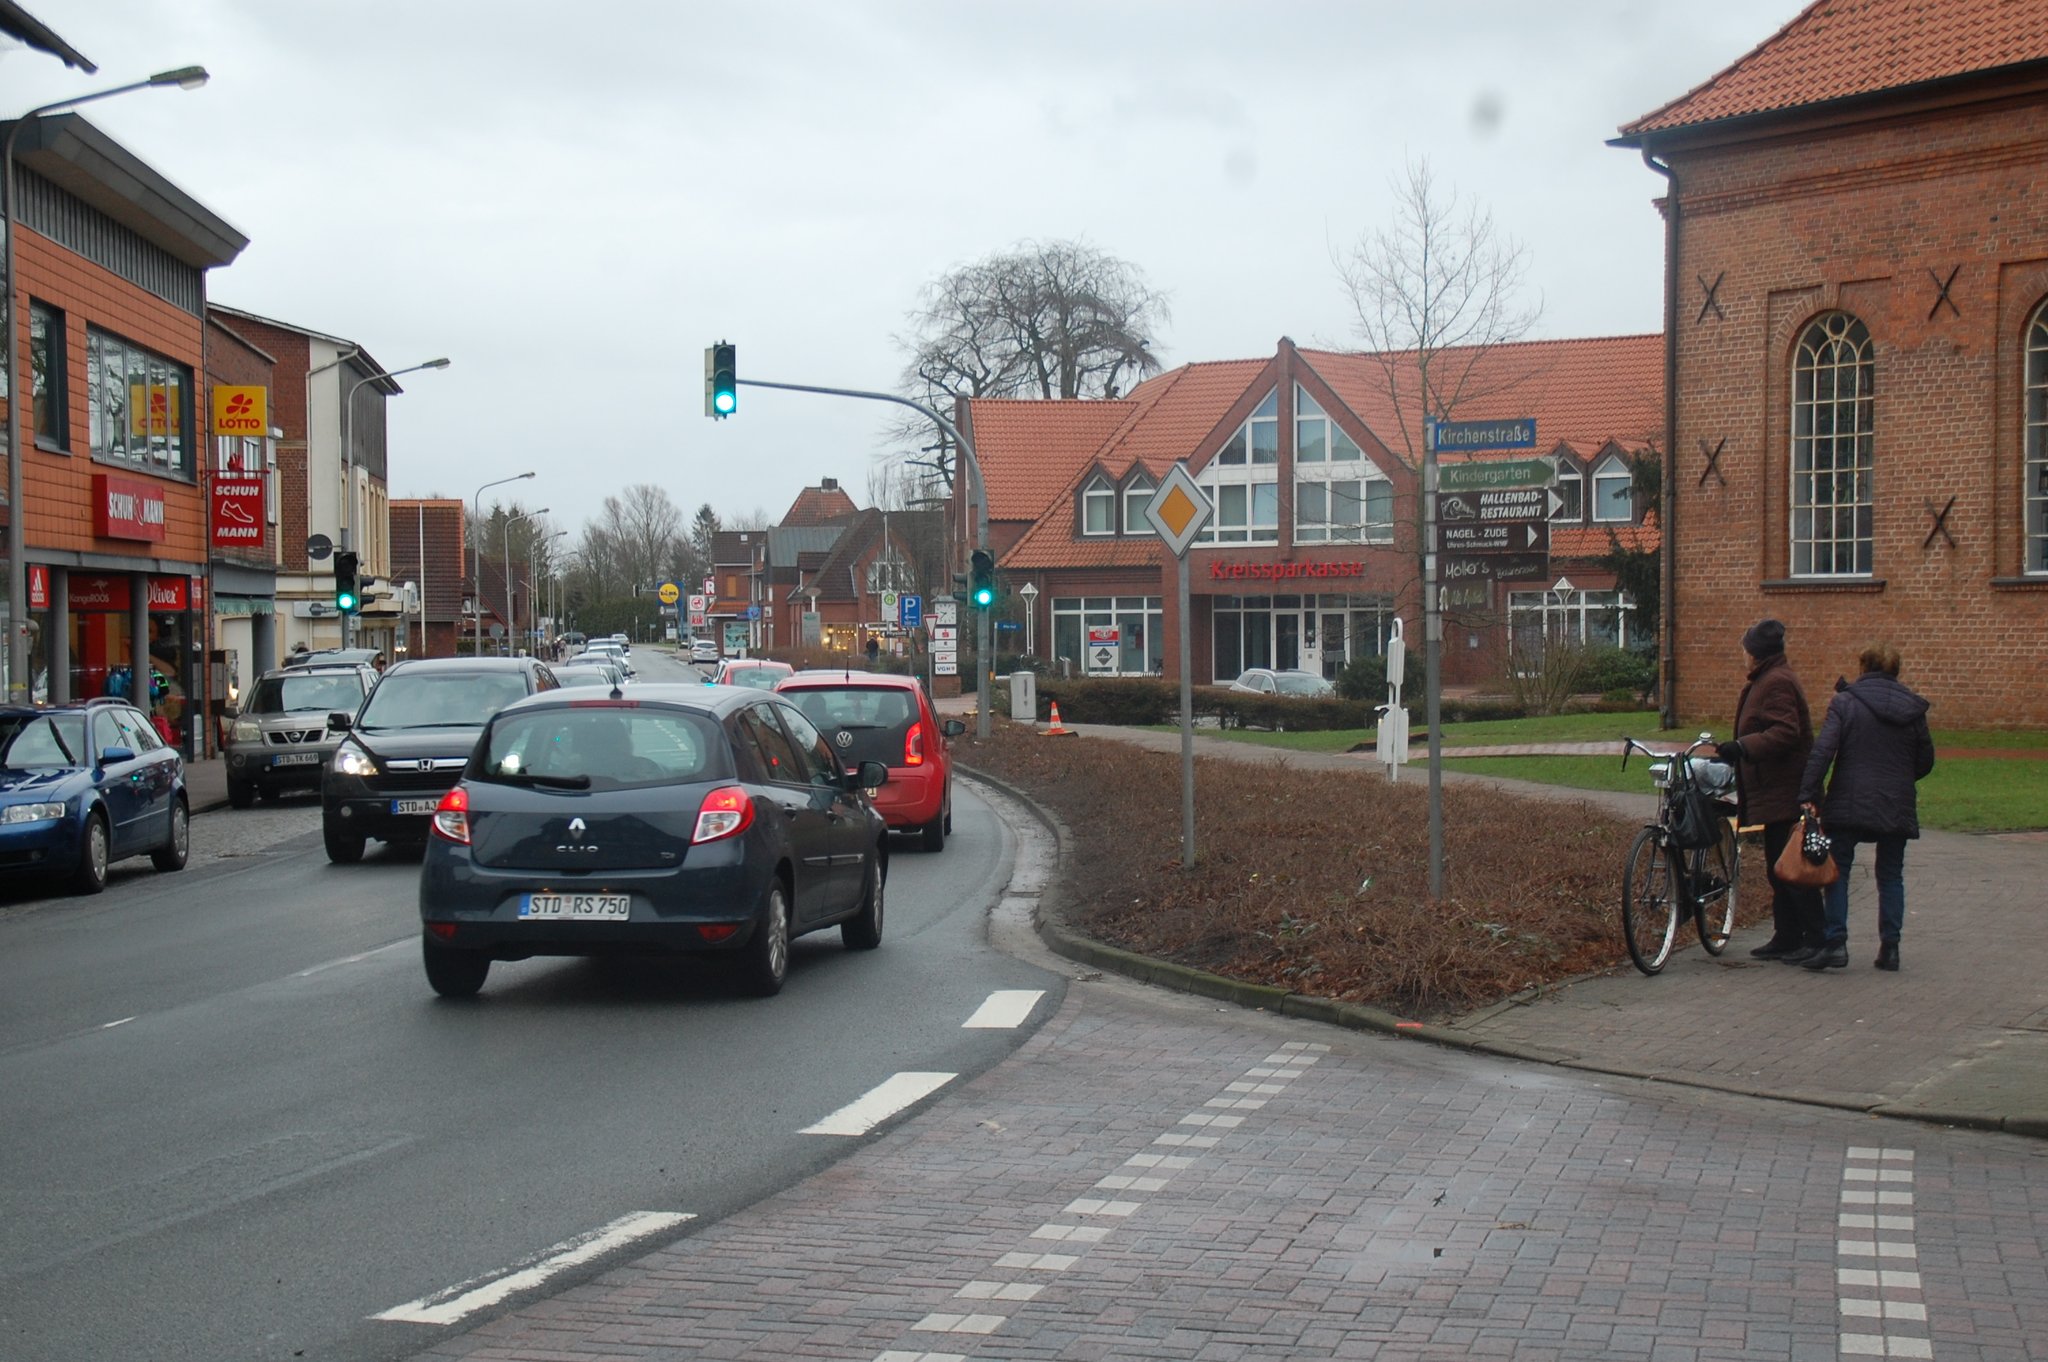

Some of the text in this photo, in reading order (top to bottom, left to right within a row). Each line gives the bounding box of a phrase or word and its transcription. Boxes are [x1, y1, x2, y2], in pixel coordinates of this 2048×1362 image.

[219, 418, 260, 429] LOTTO
[1438, 425, 1530, 445] Kirchenstraße
[1450, 467, 1531, 483] Kindergarten
[215, 485, 259, 496] SCHUH
[1480, 491, 1542, 505] HALLENBAD-
[108, 492, 164, 525] SCHUH MANN
[1480, 505, 1542, 519] RESTAURANT
[217, 527, 258, 538] MANN
[1446, 529, 1476, 539] NAGEL
[1484, 528, 1508, 538] ZUDE
[1211, 558, 1364, 583] Kreissparkasse
[905, 598, 916, 613] P
[398, 801, 417, 813] STD
[531, 896, 628, 914] STD RS 750
